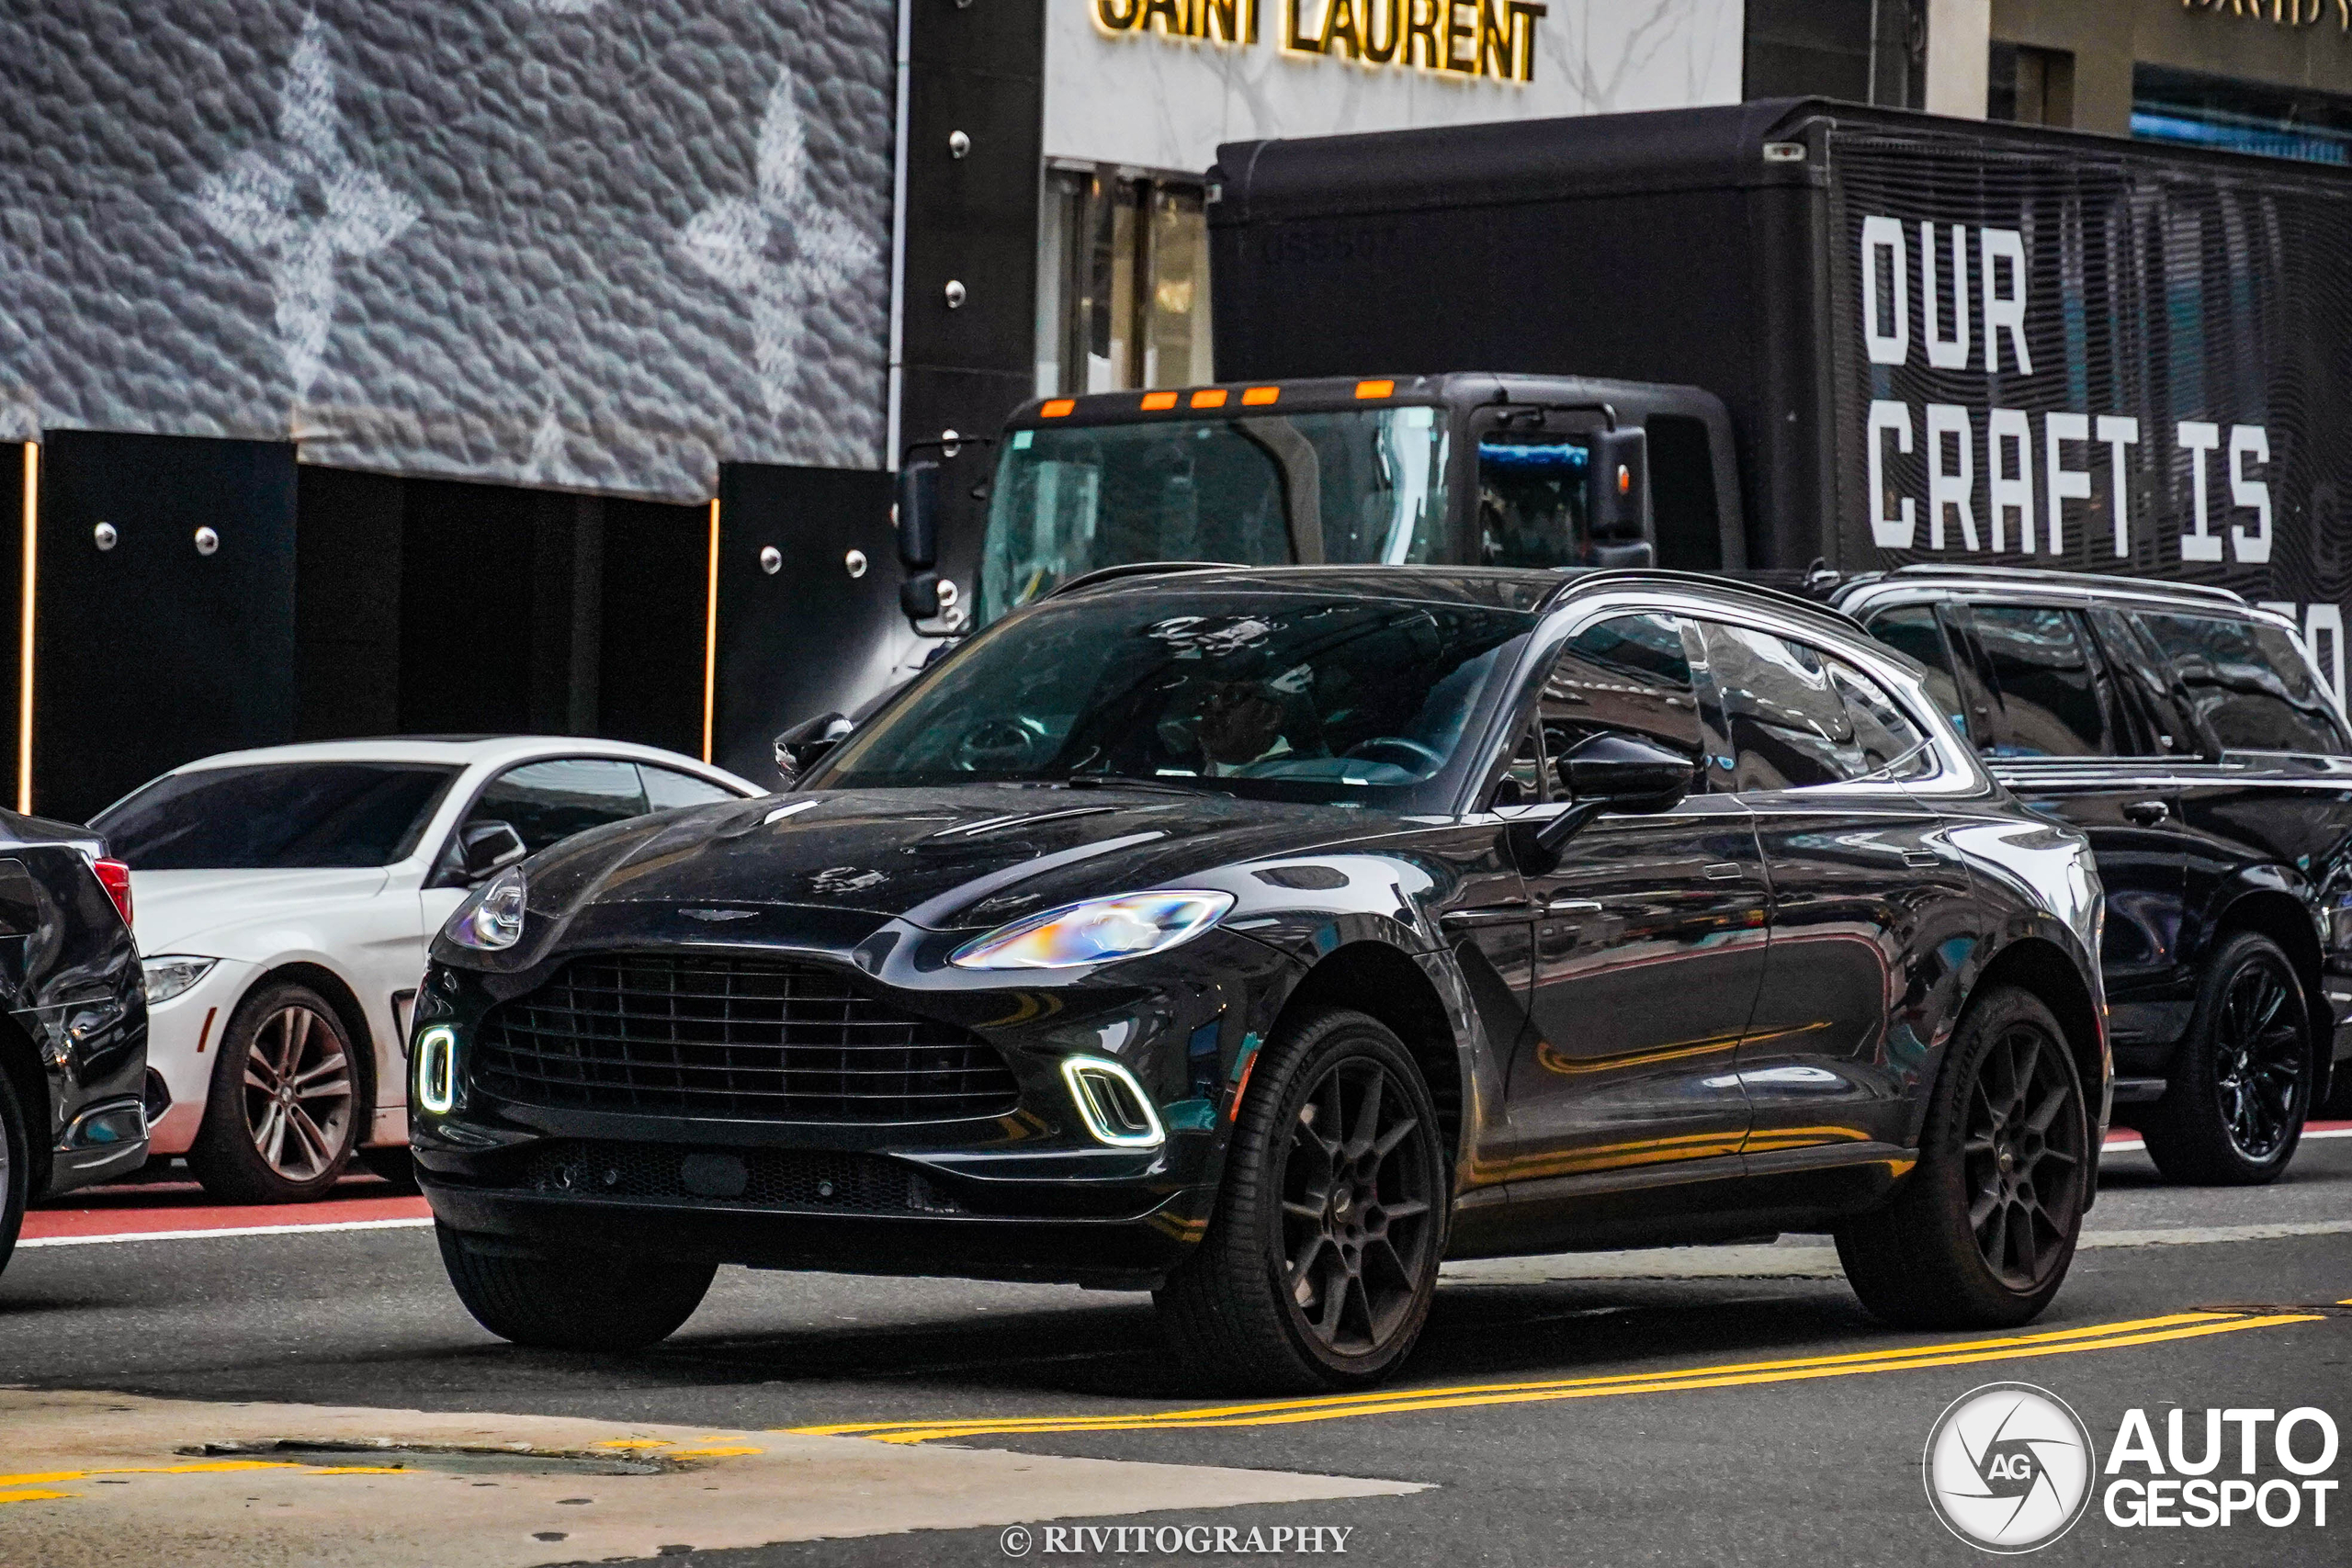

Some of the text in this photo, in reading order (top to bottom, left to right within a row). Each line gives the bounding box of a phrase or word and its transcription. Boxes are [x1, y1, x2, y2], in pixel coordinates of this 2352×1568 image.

[1282, 0, 1547, 82] LAURENT
[1862, 216, 2033, 376] OUR
[1867, 399, 2274, 563] CRAFT IS
